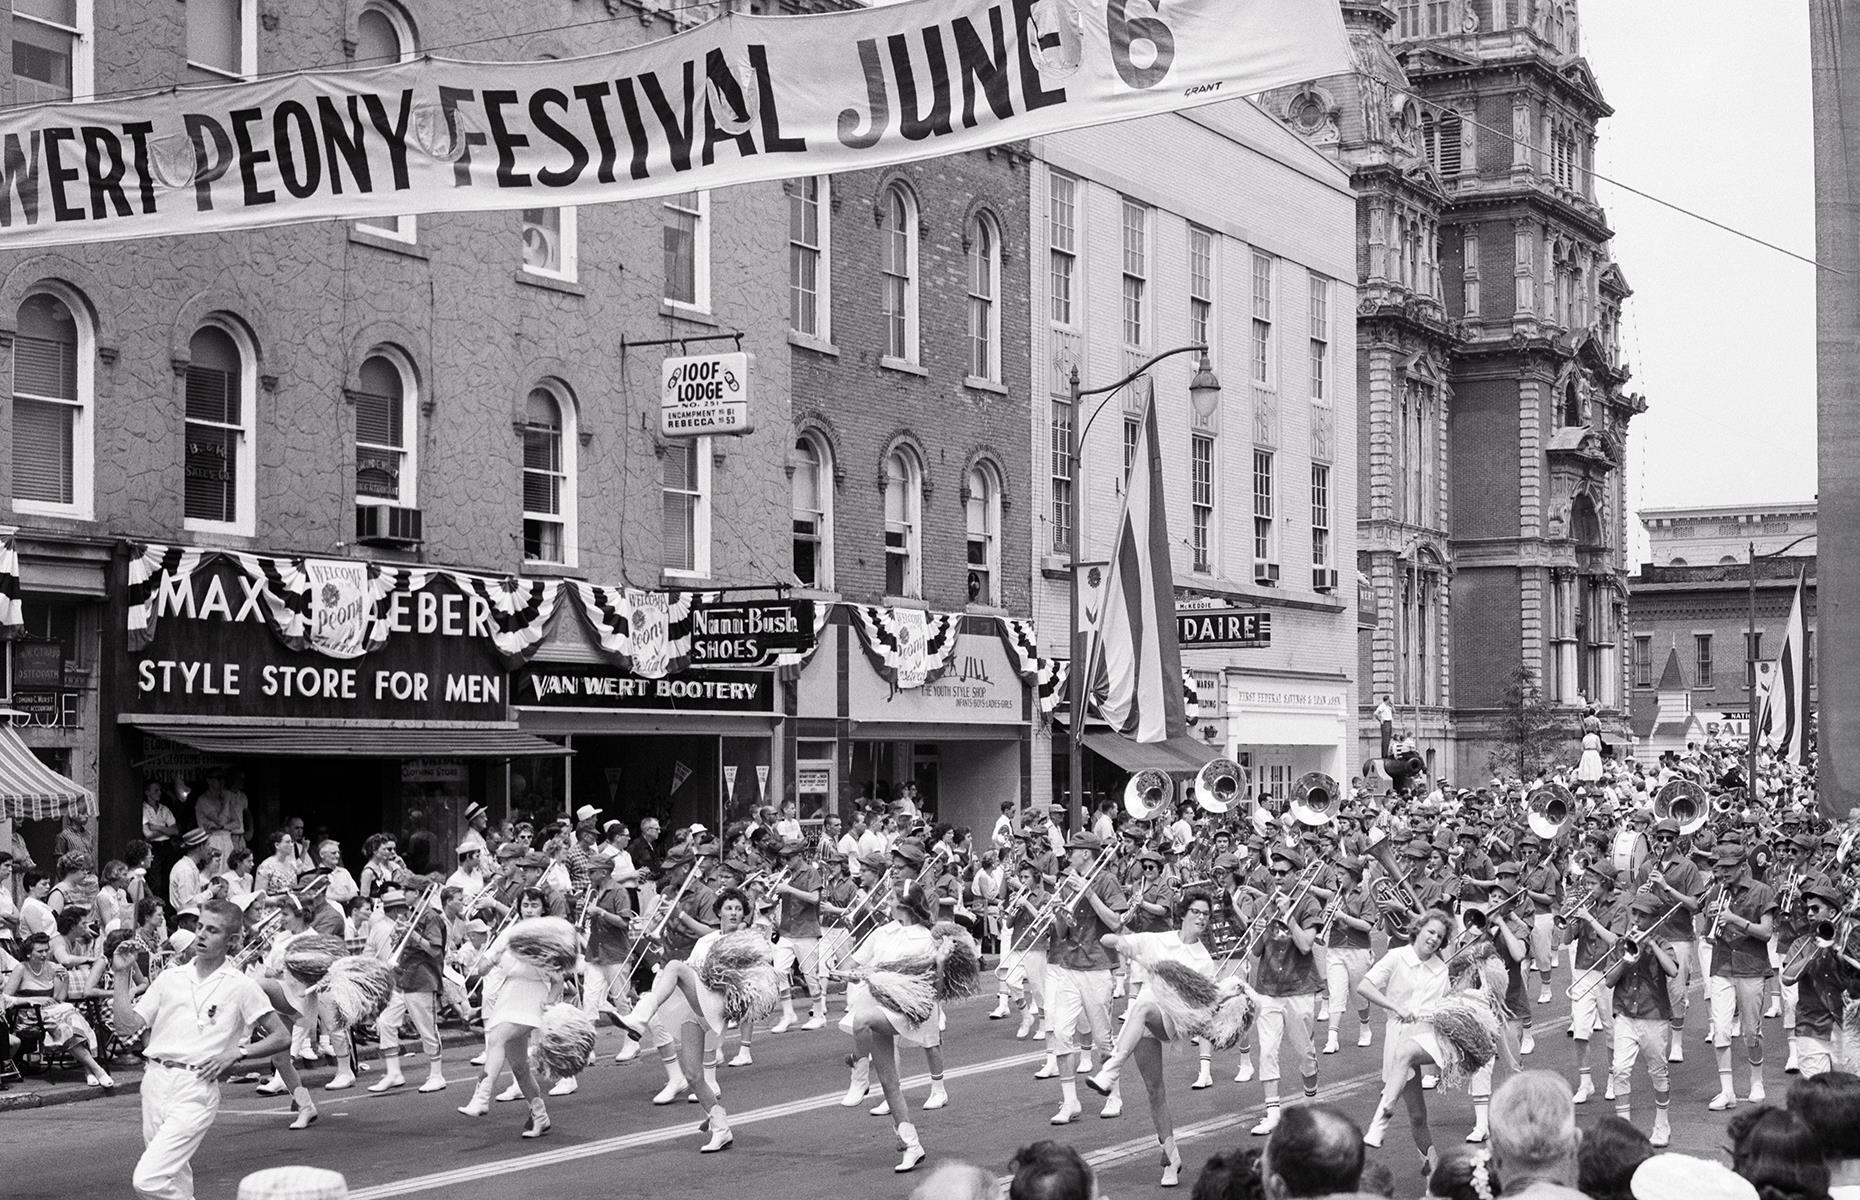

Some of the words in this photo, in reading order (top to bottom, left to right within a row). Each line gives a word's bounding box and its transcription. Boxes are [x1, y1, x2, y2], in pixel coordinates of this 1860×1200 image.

[1184, 81, 1223, 97] GRANT
[182, 88, 413, 211] PEONY
[438, 44, 807, 188] FESTIVAL
[837, 0, 1067, 150] JUNE
[1107, 0, 1176, 90] 6
[678, 381, 723, 402] LODGE
[668, 409, 716, 419] ENCAMPMENT
[668, 418, 715, 428] REBECCA
[158, 568, 266, 624] MAX
[694, 640, 758, 659] SHOES
[138, 660, 240, 695] STYLE
[261, 665, 356, 699] STORE
[375, 671, 429, 702] FOR
[445, 674, 500, 703] MEN
[531, 674, 578, 701] VAN
[583, 677, 649, 697] WERT
[656, 680, 757, 699] BOOTERY
[933, 686, 951, 697] YOUTH
[952, 686, 970, 697] STYLE
[972, 686, 986, 698] SHOP
